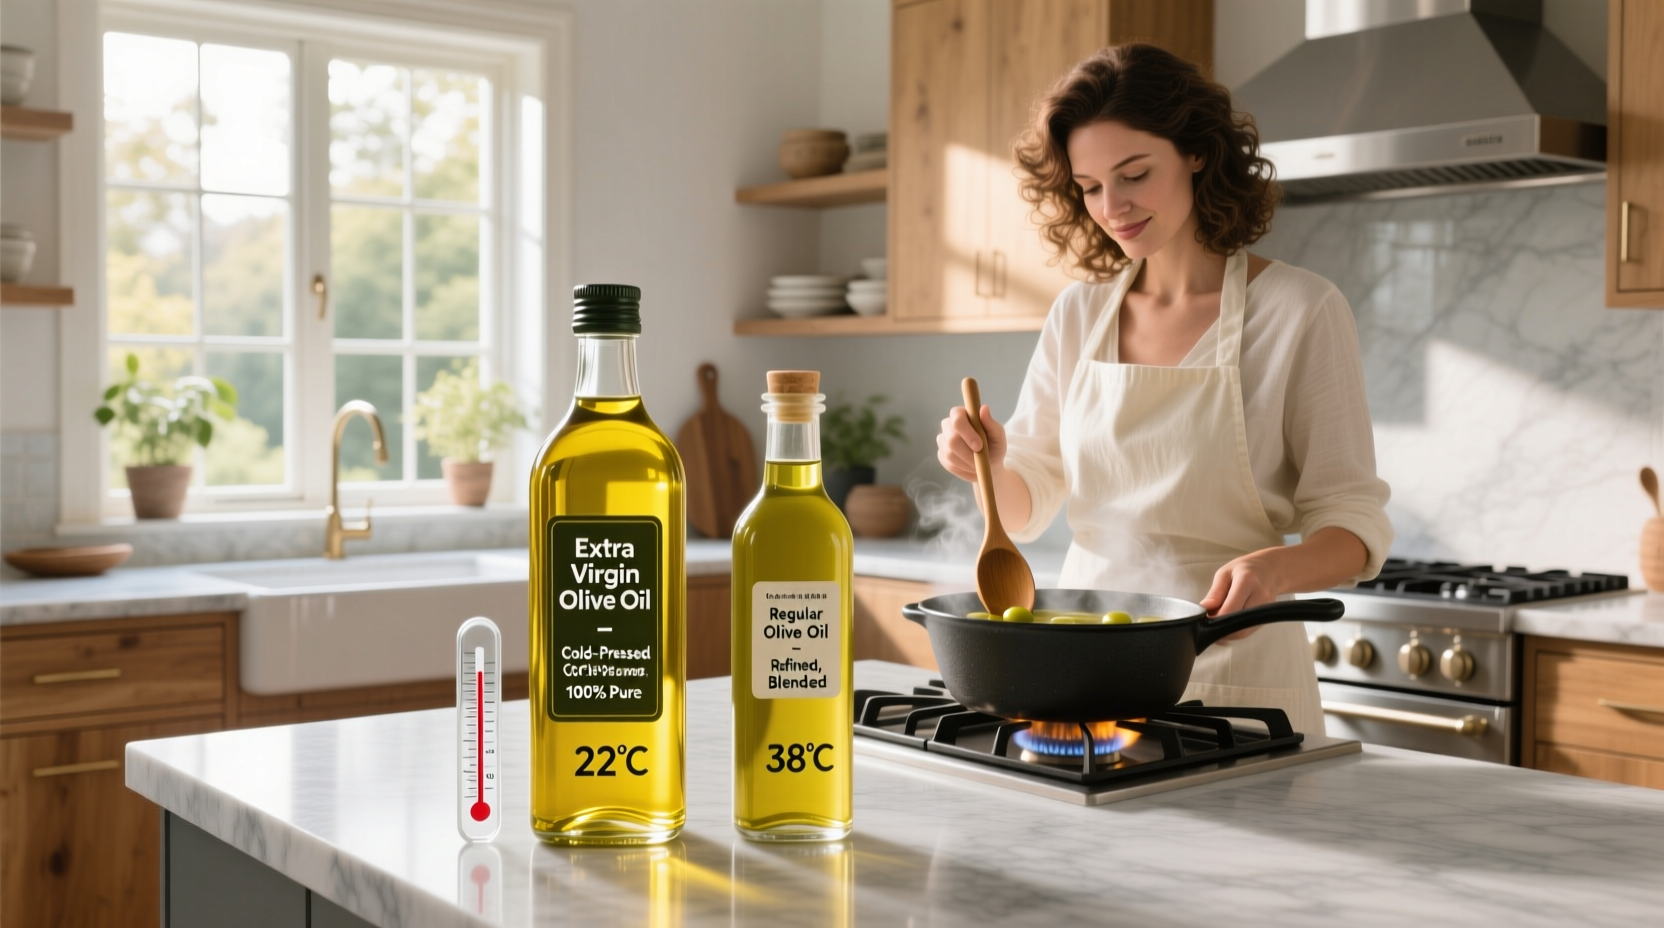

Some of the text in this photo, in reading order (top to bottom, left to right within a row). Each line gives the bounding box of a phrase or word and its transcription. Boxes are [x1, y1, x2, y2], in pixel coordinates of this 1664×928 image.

[575, 537, 635, 558] Extra
[570, 563, 640, 590] Virgin
[559, 589, 651, 610] Olive Oil
[769, 606, 823, 624] Regular
[763, 623, 829, 639] Olive Oil
[566, 685, 643, 699] 100% Pure
[768, 674, 827, 689] Blended
[574, 744, 649, 777] 22°C
[765, 742, 834, 773] 38°C
